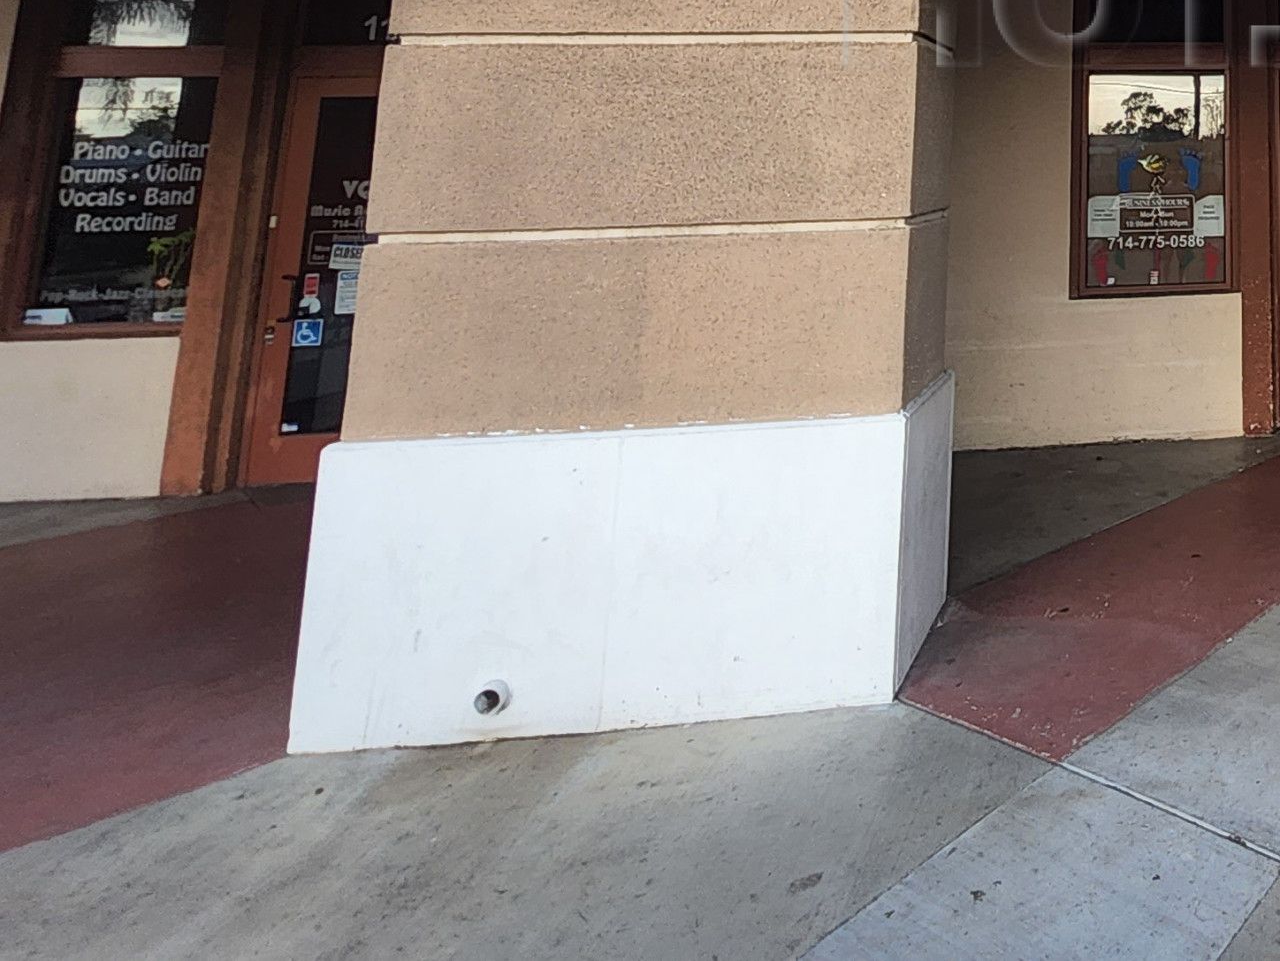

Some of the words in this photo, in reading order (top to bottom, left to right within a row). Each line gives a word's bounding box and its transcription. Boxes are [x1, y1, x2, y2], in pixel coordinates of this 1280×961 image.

[72, 141, 131, 161] Piano
[147, 140, 209, 159] Guitar
[59, 165, 128, 185] Drums
[145, 162, 202, 183] Violin
[58, 187, 127, 207] Vocals
[143, 186, 196, 206] Band
[74, 213, 179, 233] Recording
[1107, 235, 1205, 251] 714-775-0586
